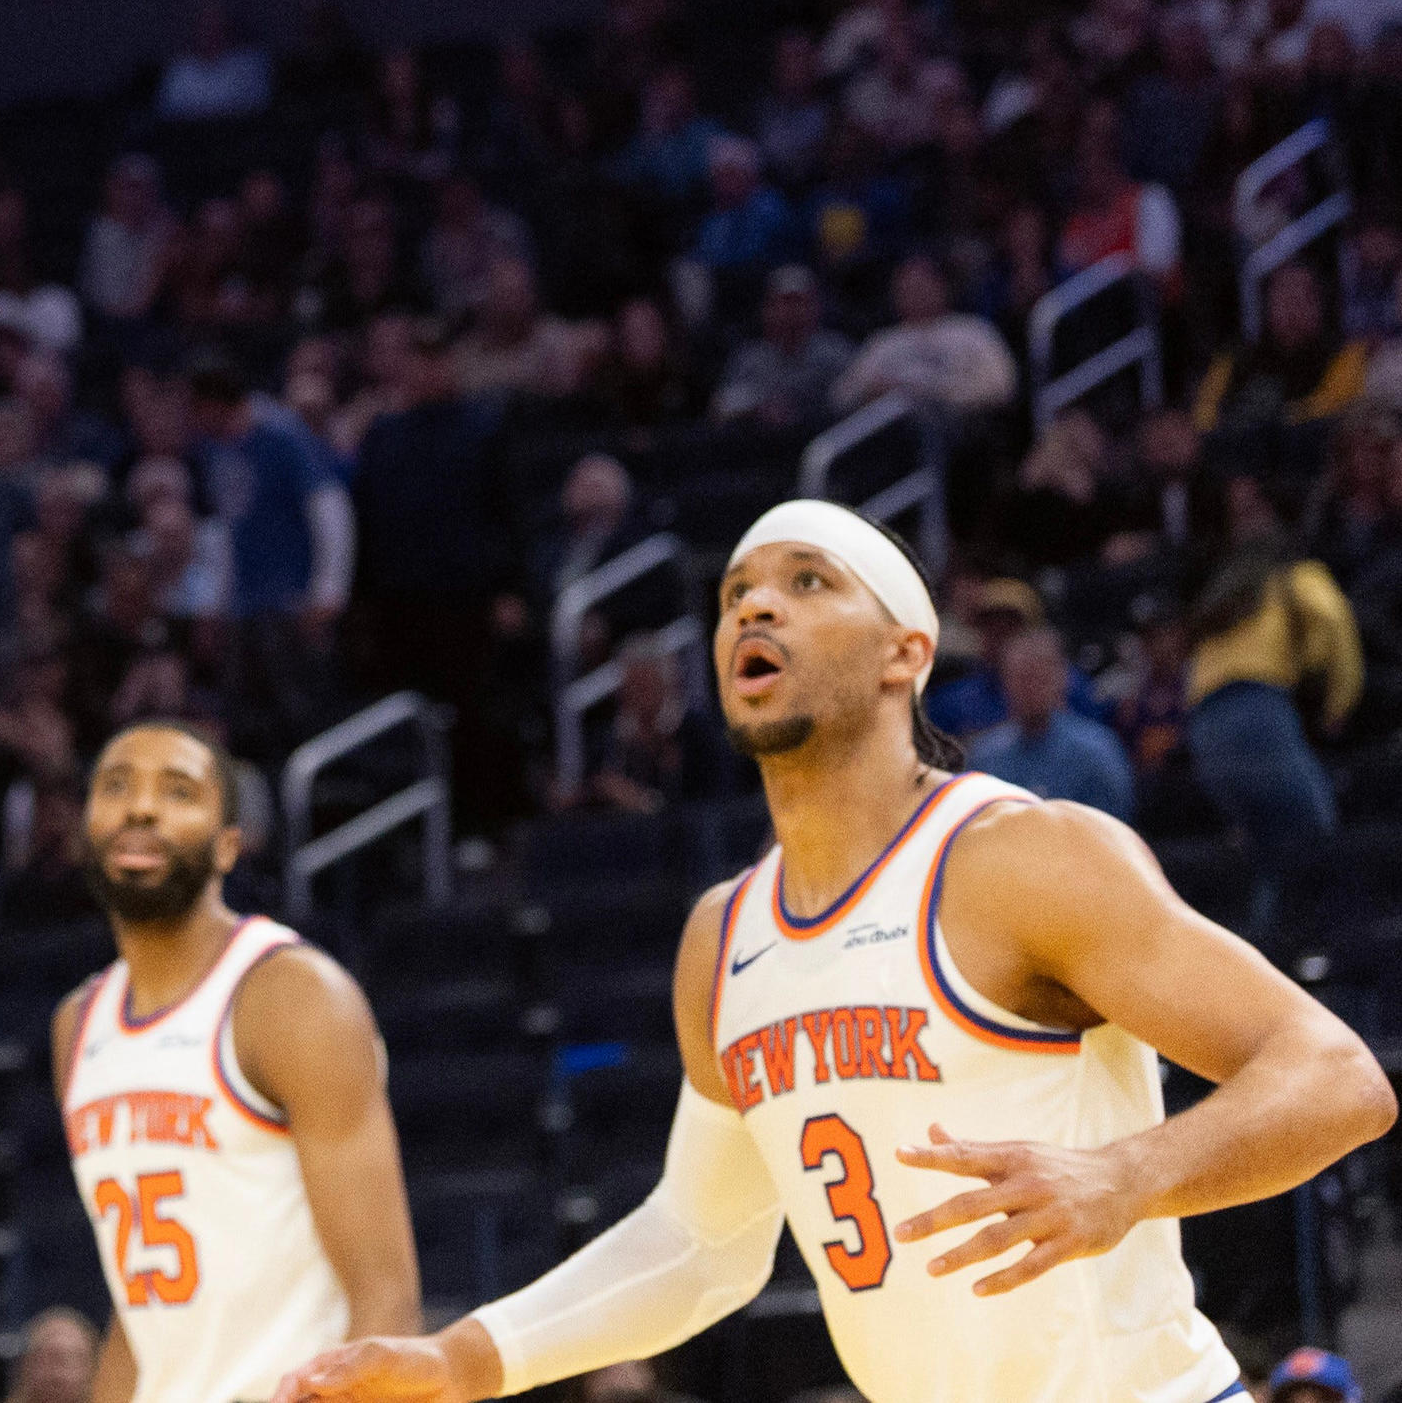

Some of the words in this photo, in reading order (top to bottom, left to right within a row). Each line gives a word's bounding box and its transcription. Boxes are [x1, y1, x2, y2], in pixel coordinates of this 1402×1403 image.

[720, 1013, 798, 1117] NEW
[799, 1004, 943, 1085] YORK
[94, 1169, 201, 1307] 25
[800, 1112, 892, 1293] 3
